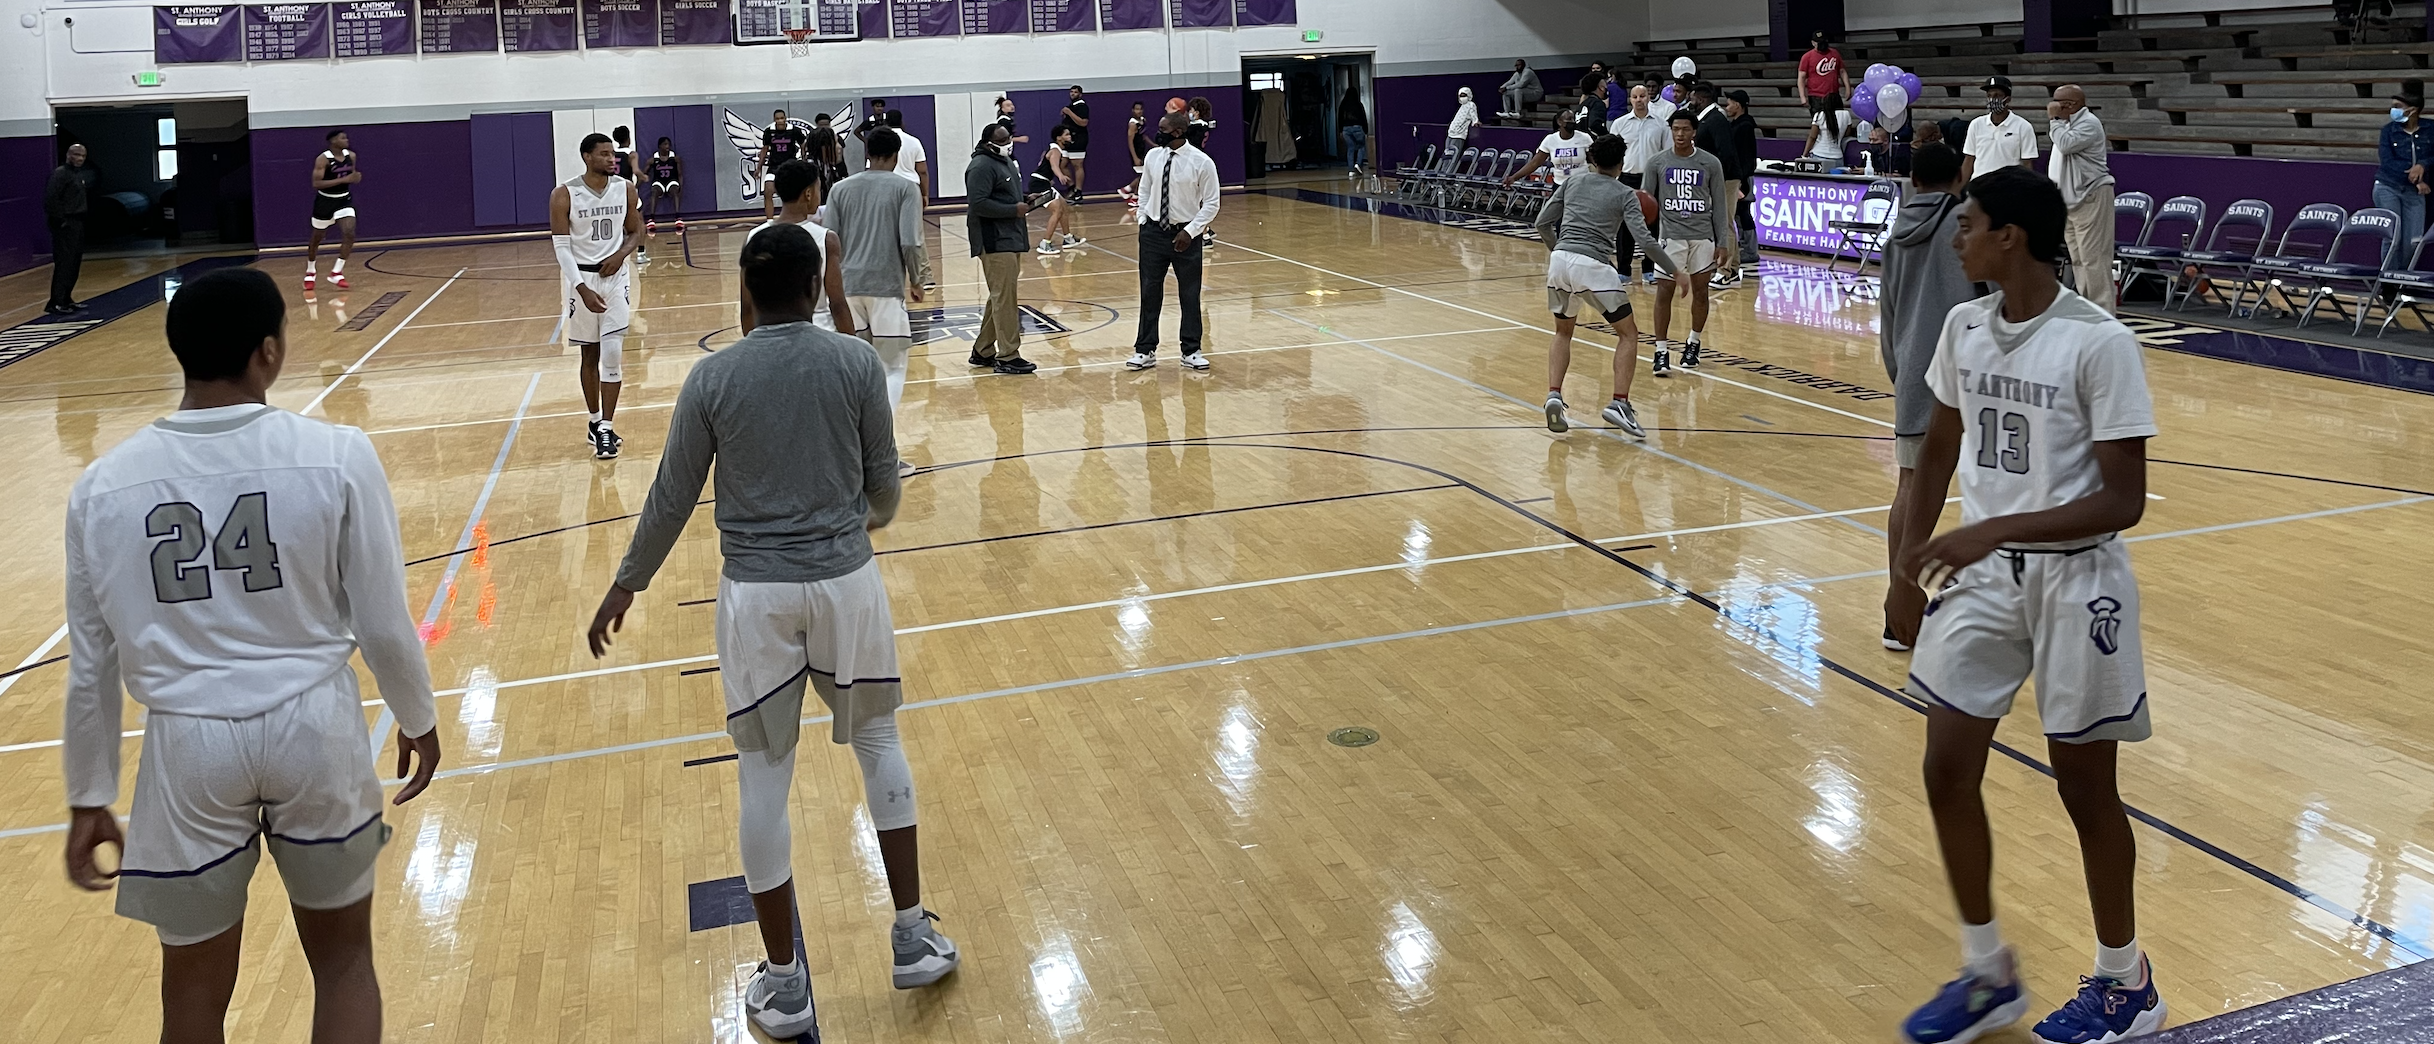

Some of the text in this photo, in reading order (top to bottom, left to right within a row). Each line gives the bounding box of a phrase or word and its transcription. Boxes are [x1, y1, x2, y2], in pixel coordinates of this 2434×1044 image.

[363, 10, 406, 18] VOLLEYBALL
[464, 7, 494, 15] COUNTRY
[176, 18, 198, 26] GIRLS
[1815, 57, 1837, 76] Cali
[1556, 149, 1574, 157] JUST
[1669, 168, 1700, 185] JUST
[1676, 185, 1693, 199] US
[1762, 183, 1858, 202] ST. ANTHONY
[1868, 184, 1890, 194] SAINTS
[1665, 199, 1705, 212] SAINTS
[2114, 199, 2146, 209] SAINTS
[2163, 203, 2198, 214] SAINTS
[591, 205, 623, 217] ANTHONY
[1759, 197, 1858, 237] SAINTS
[2228, 205, 2265, 218] SAINTS
[2299, 210, 2339, 222] SAINTS
[2351, 215, 2391, 228] SAINTS
[592, 219, 613, 241] 10
[1765, 229, 1792, 244] FEAR
[1796, 234, 1816, 246] THE
[1977, 373, 2059, 409] ANTHONY
[1977, 407, 2030, 475] 13
[145, 491, 283, 603] 24
